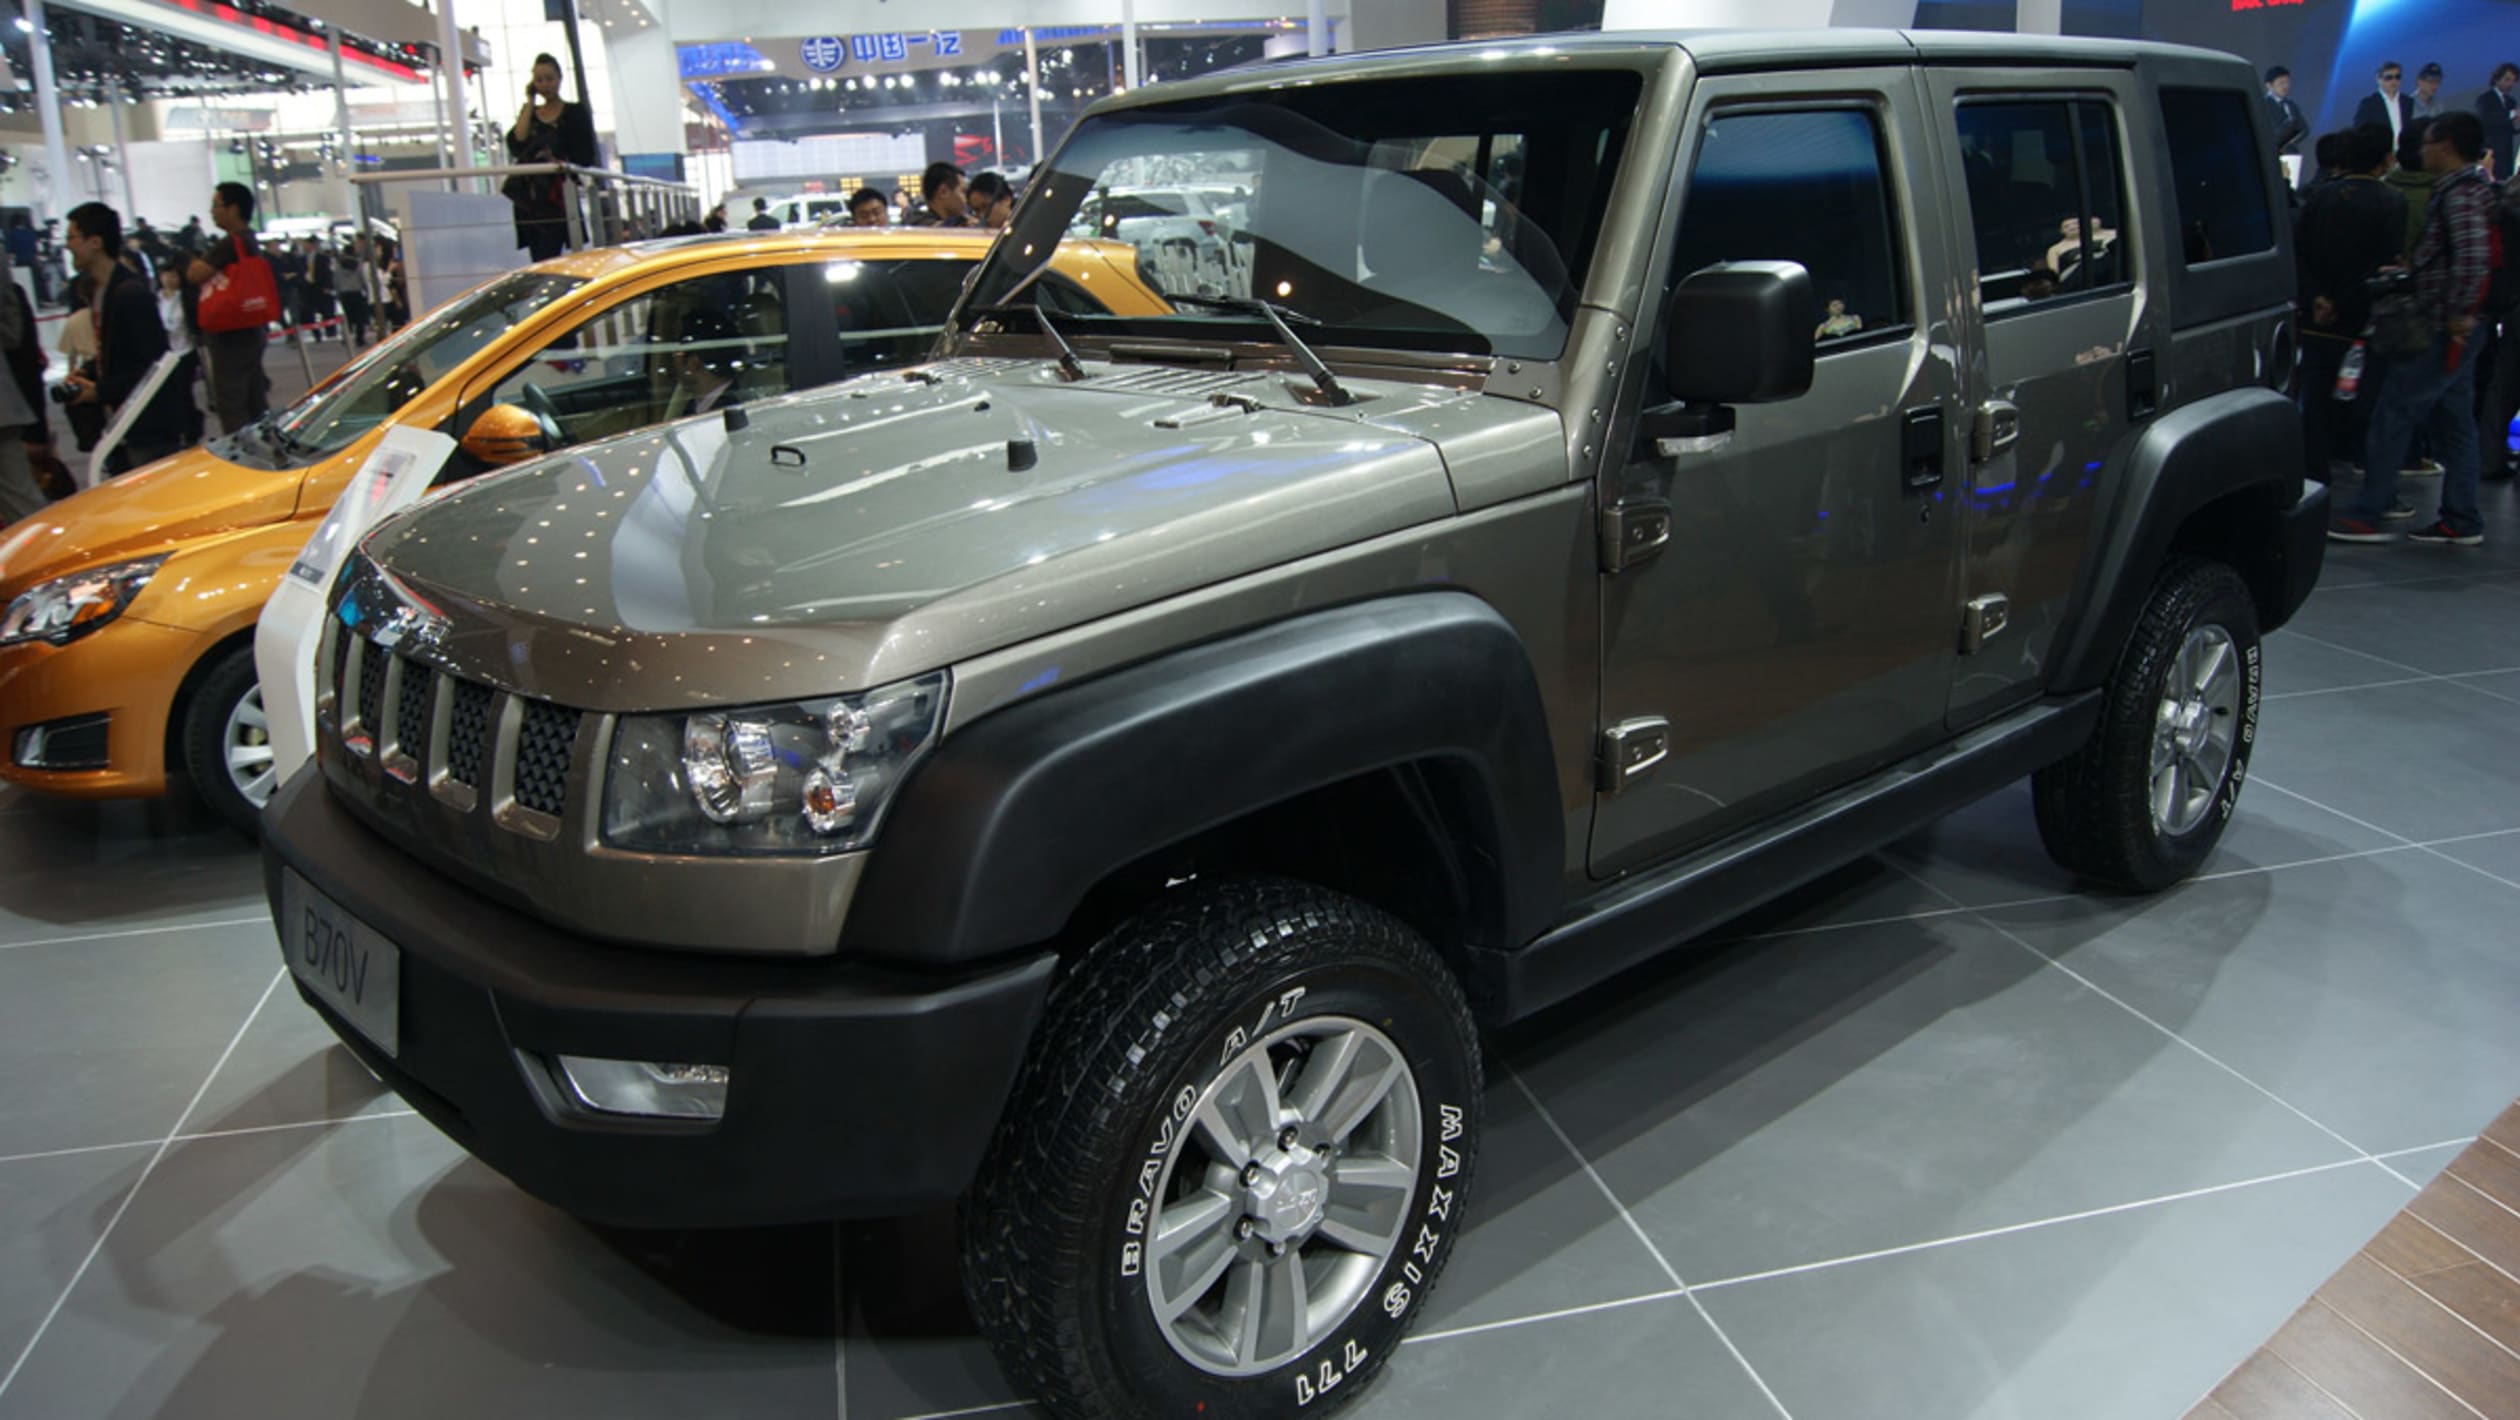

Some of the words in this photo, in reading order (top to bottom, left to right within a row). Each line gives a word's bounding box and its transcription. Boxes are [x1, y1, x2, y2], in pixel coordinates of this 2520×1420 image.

[851, 31, 962, 62] 中国一汽
[1121, 1084, 1198, 1277] BRAVO
[1220, 986, 1306, 1065] A/T
[1385, 1104, 1464, 1318] MAXXIS
[1296, 1339, 1368, 1406] 771
